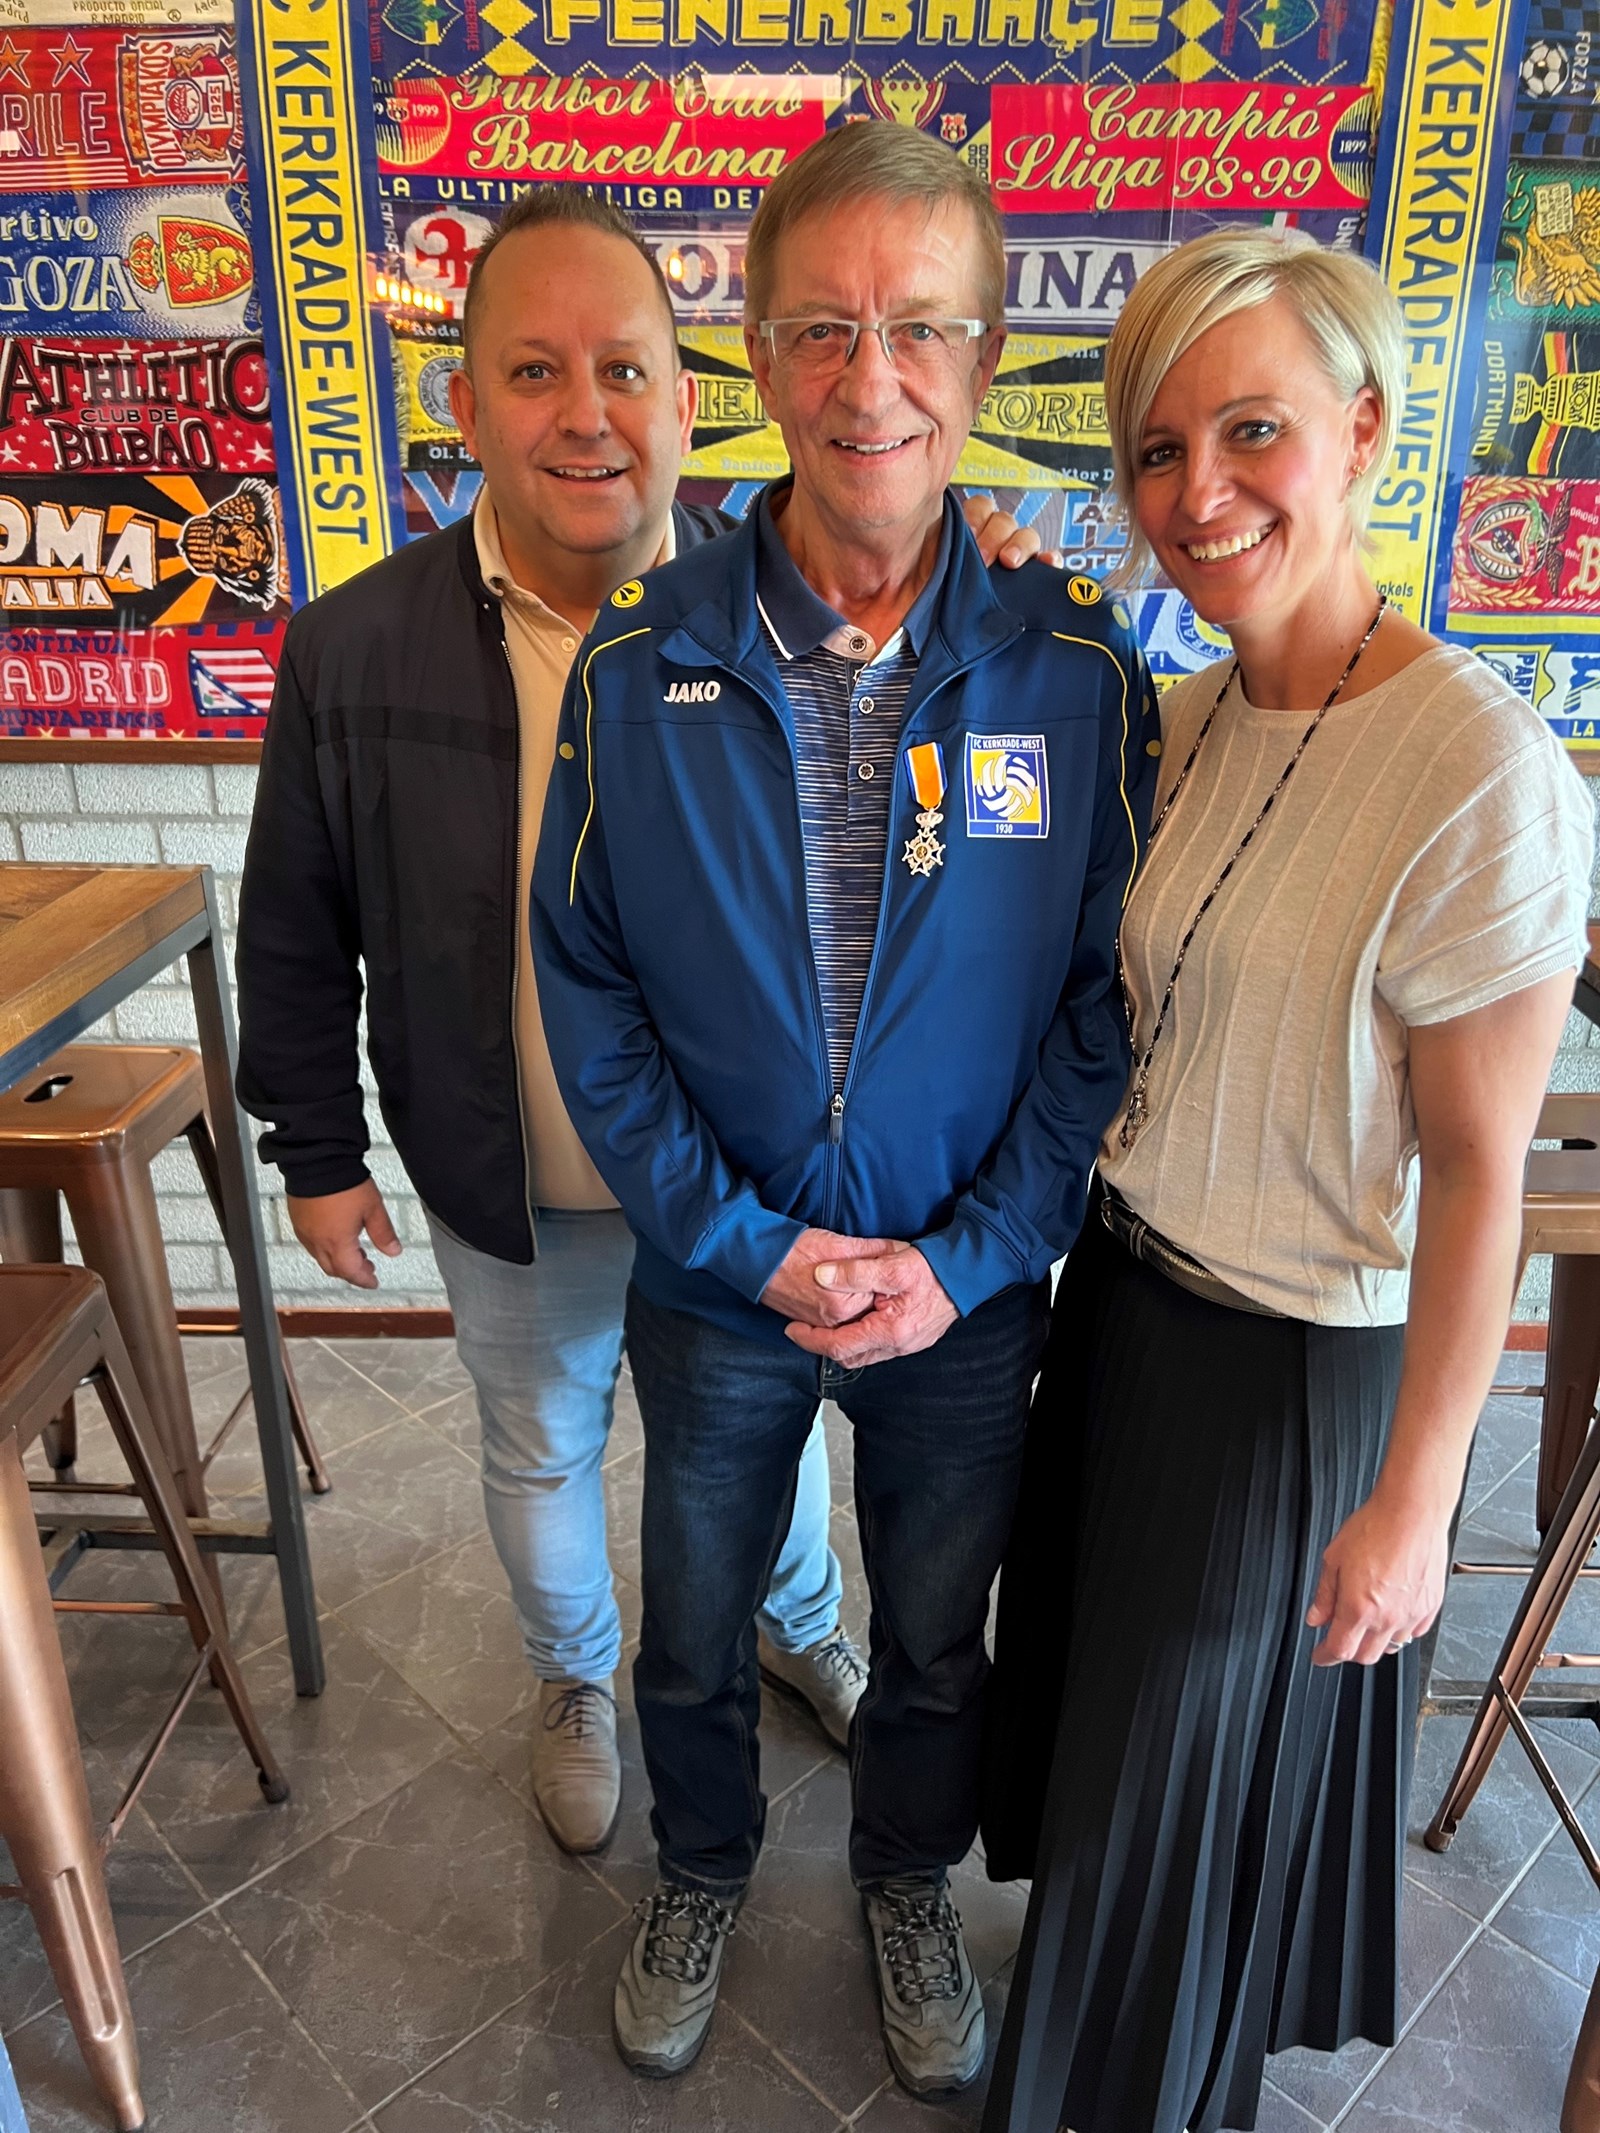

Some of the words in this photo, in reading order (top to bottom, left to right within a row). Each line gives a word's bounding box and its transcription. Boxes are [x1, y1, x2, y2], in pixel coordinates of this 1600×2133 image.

[103, 13, 145, 23] MADRID
[544, 0, 1162, 58] FENERBAHÇE
[1570, 31, 1591, 94] FORZA
[139, 41, 187, 167] OLYMPIAKOS
[210, 86, 223, 118] 1925
[411, 103, 440, 117] 1999
[1083, 83, 1336, 161] Campió
[467, 114, 790, 177] Barcelona
[1339, 140, 1367, 154] 1899
[379, 178, 410, 197] LA
[438, 180, 548, 202] ULTIM
[0, 208, 98, 241] rtivo
[0, 255, 142, 312] GOZA
[272, 40, 369, 545] KERKRADE-WEST
[0, 337, 272, 428] ATHLETIC
[1471, 340, 1507, 456] DORTMUND
[81, 409, 141, 423] CLUB
[149, 408, 177, 422] DE
[43, 418, 220, 472] BILBAO
[663, 681, 721, 703] JAKO
[973, 738, 982, 749] FC
[982, 738, 1040, 749] KERKRADE-WEST
[995, 823, 1013, 834] 1930
